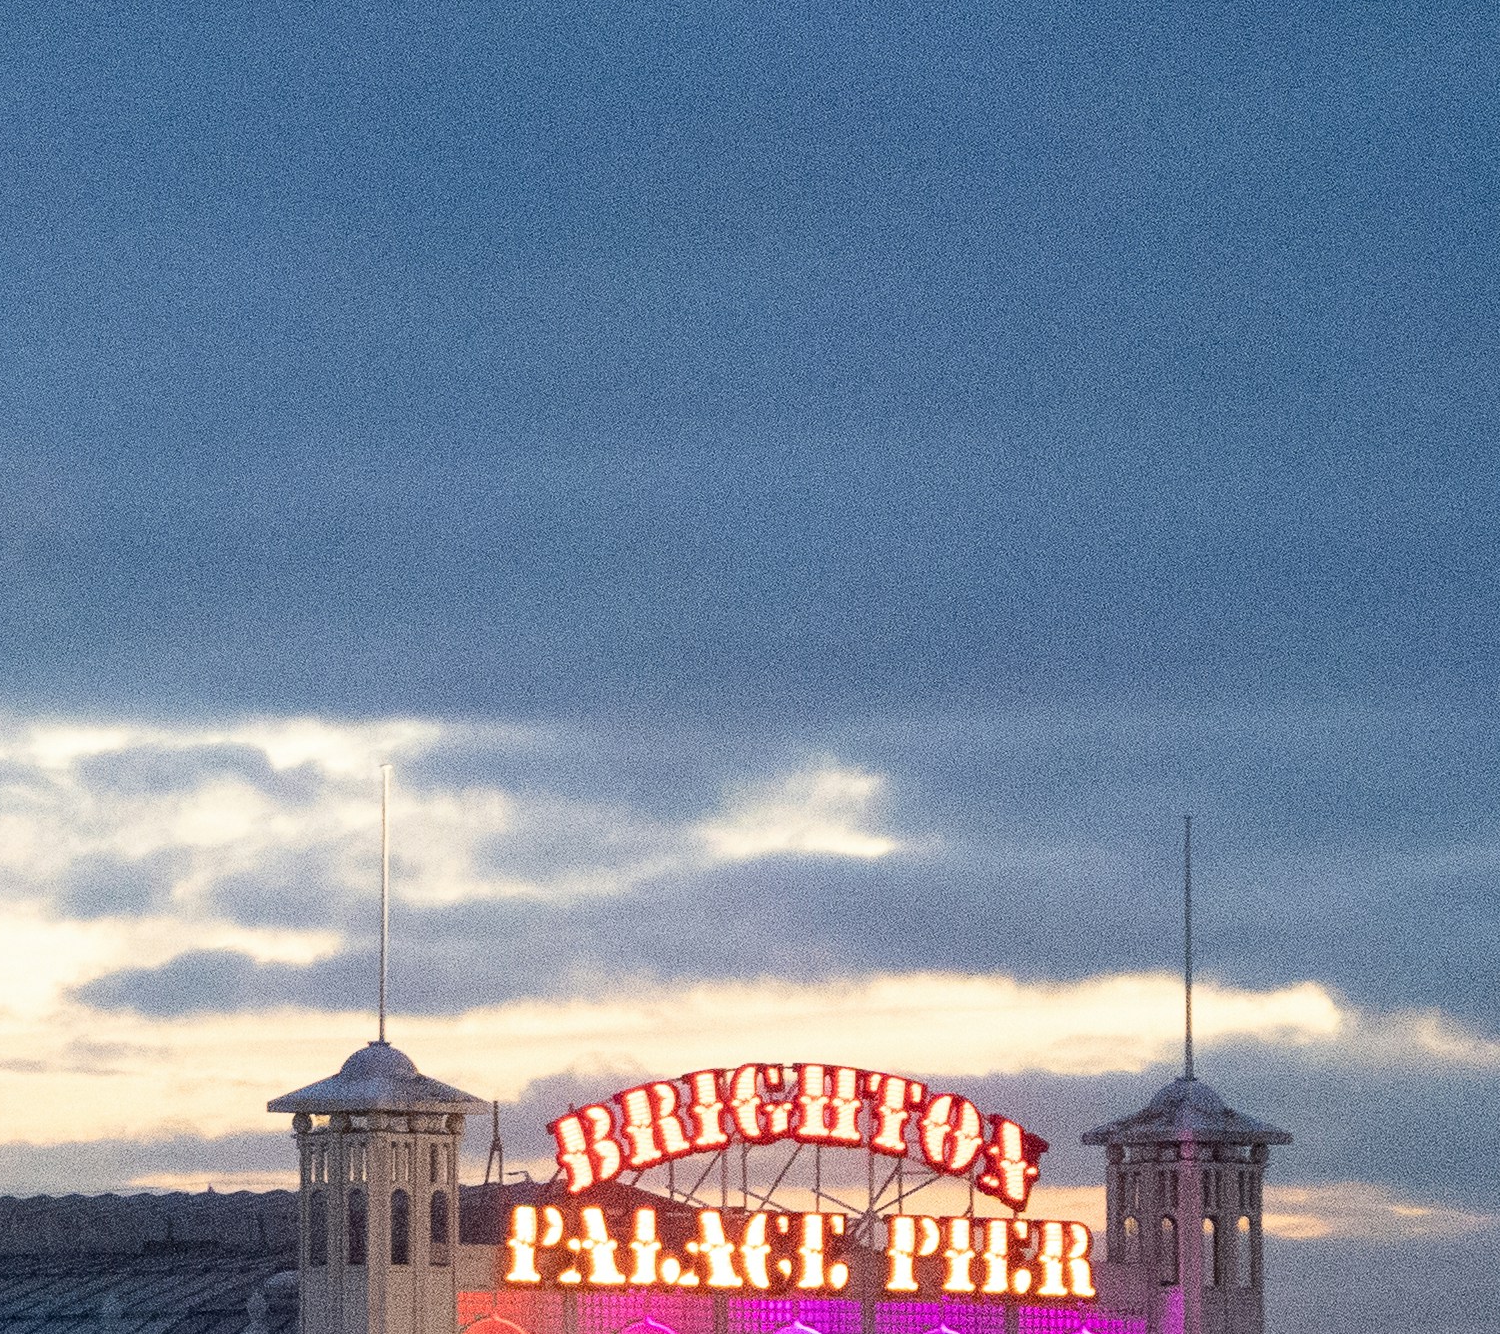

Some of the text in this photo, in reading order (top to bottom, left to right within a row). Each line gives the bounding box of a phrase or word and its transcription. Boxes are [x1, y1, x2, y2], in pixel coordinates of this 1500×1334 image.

[548, 1063, 1049, 1214] BRIGHTON
[504, 1204, 1098, 1301] PALACE PIER
